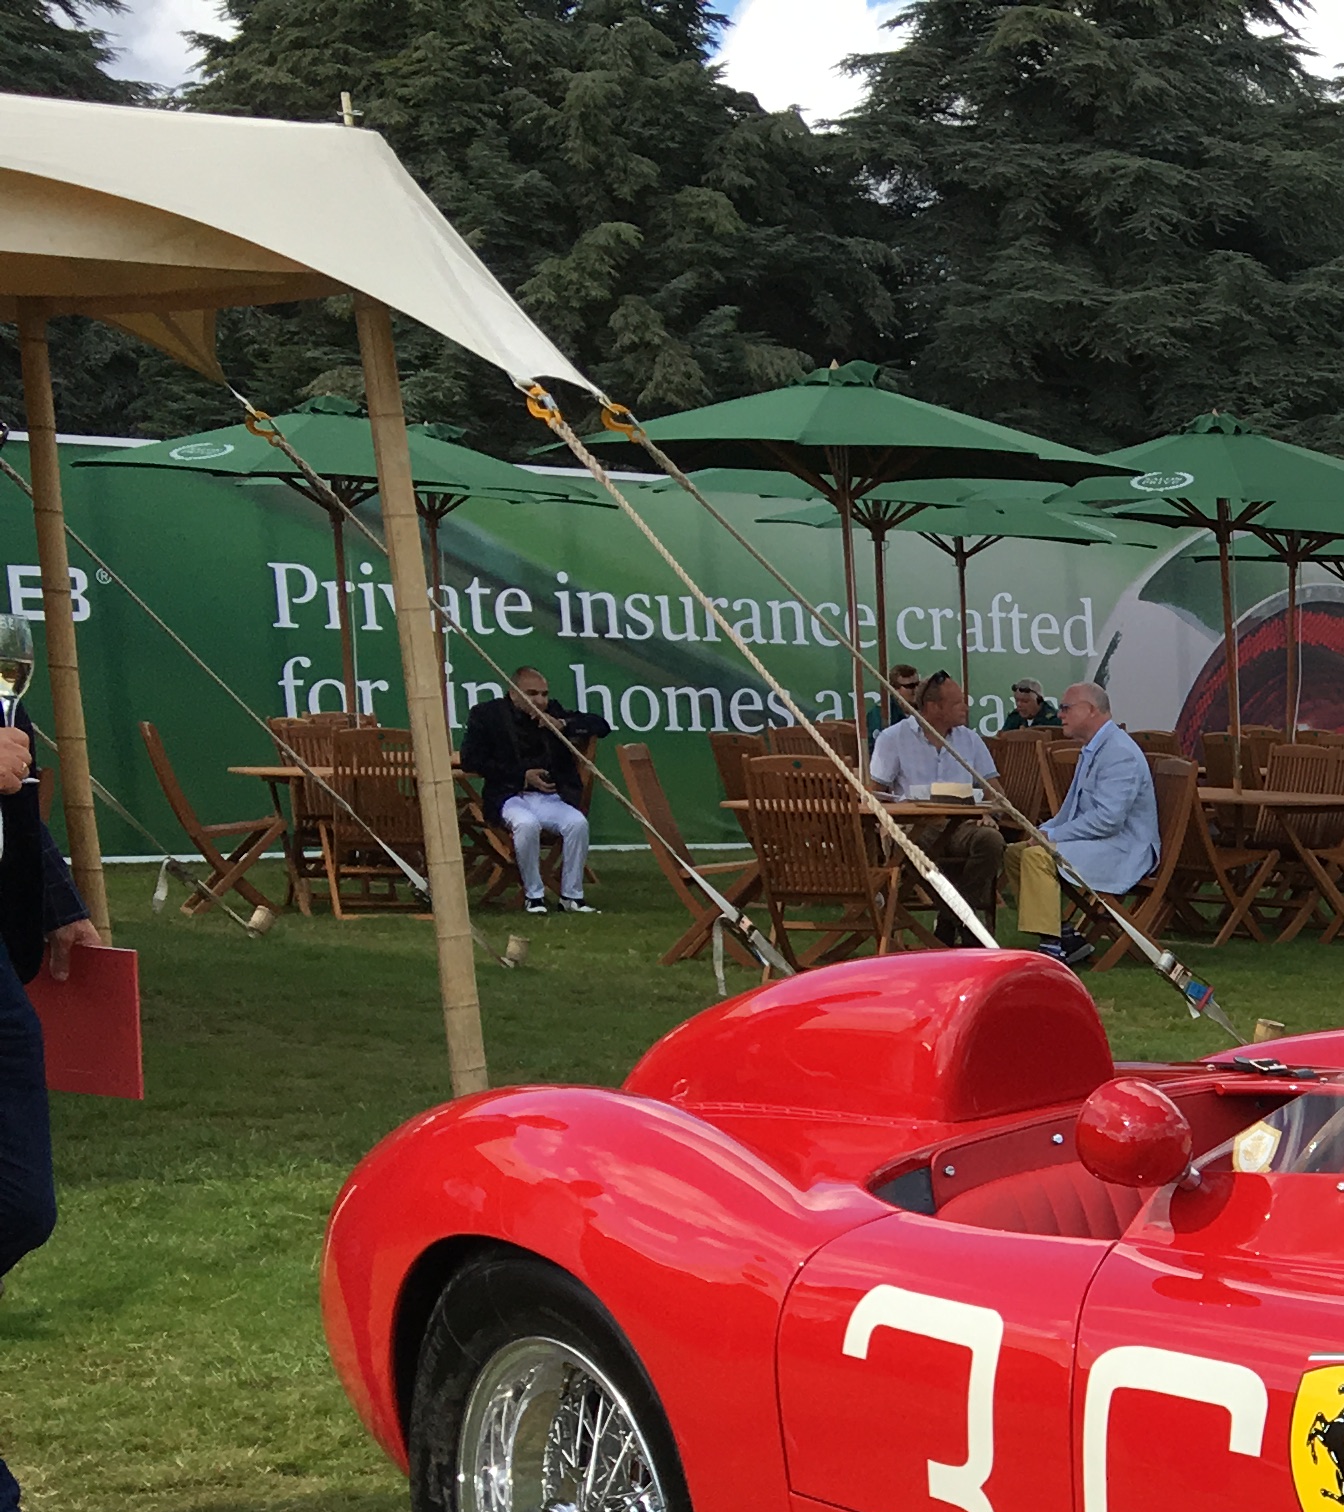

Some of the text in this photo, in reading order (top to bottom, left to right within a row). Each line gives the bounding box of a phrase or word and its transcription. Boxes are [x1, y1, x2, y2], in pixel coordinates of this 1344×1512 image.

[554, 571, 877, 648] insurance
[896, 592, 1098, 657] crafted
[278, 656, 389, 728] for
[569, 664, 795, 733] homes
